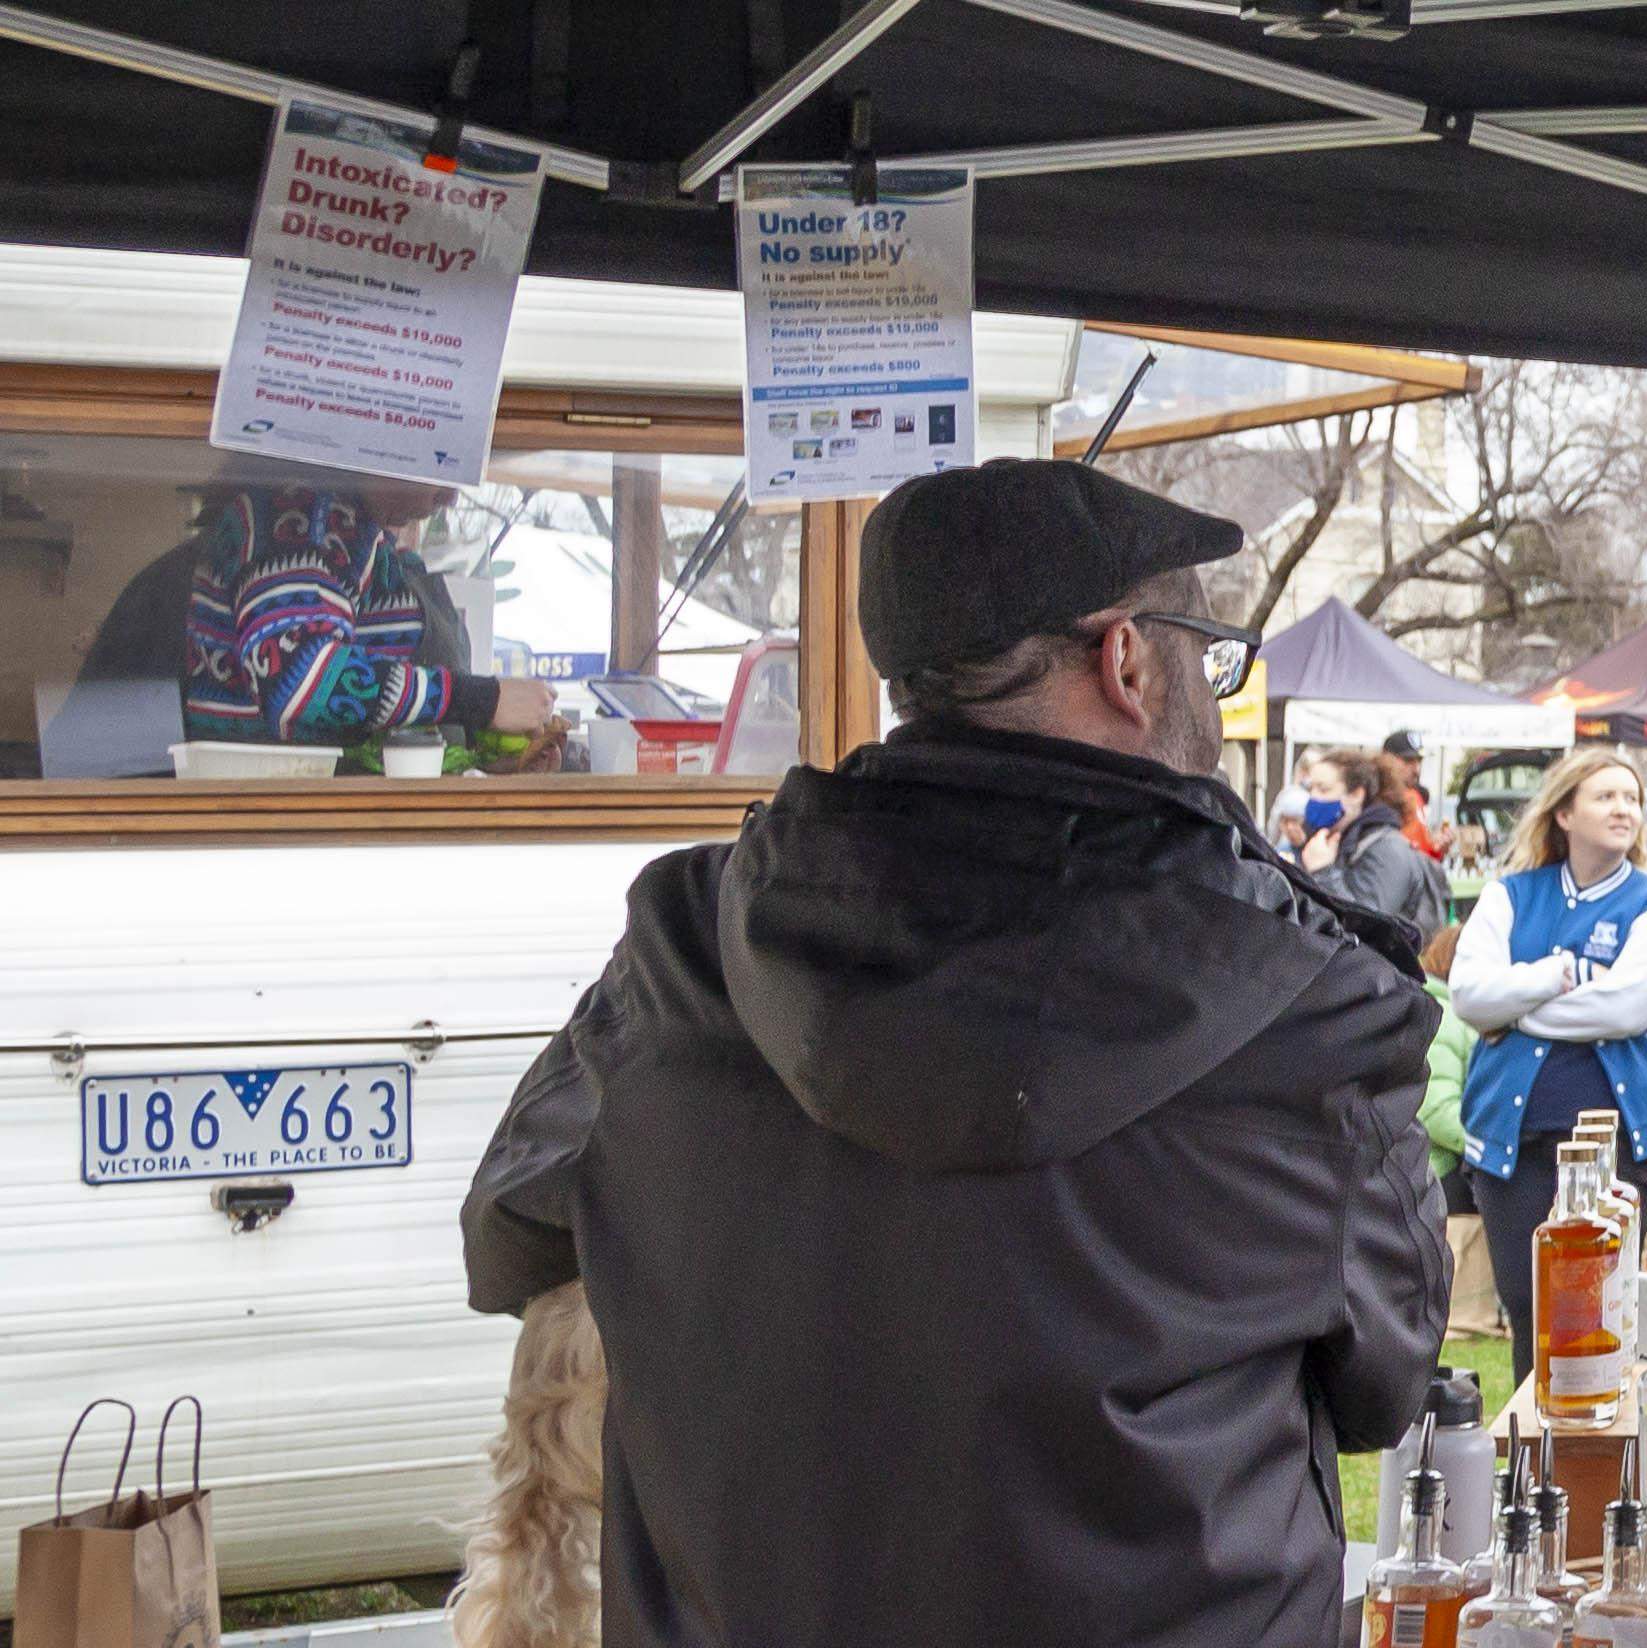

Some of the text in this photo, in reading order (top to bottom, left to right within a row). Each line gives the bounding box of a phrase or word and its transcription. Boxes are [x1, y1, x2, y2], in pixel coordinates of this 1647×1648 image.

[294, 147, 508, 213] Intoxicated?
[288, 179, 411, 225] Drunk?
[758, 209, 907, 235] Under 18?
[281, 211, 476, 273] Disorderly?
[760, 241, 800, 264] No
[305, 264, 360, 286] against
[363, 274, 387, 290] the
[789, 270, 836, 284] against
[839, 269, 860, 281] the
[769, 298, 822, 312] Penalty
[824, 296, 882, 310] exceeds
[272, 300, 333, 326] Penalty
[335, 315, 398, 337] exceeds
[401, 326, 464, 350] $19,000
[771, 321, 939, 341] Penalty exceeds $19,000
[263, 344, 454, 391] Penalty exceeds $19,000
[773, 363, 824, 378] Penalty
[828, 362, 885, 376] exceeds
[255, 386, 316, 412] Penalty
[318, 401, 381, 421] exceeds
[97, 1079, 397, 1156] U86 663
[97, 1155, 191, 1176] VICTORIA
[222, 1151, 258, 1168] THE
[269, 1147, 328, 1165] PLACE
[339, 1145, 363, 1161] TO
[374, 1143, 396, 1159] BE
